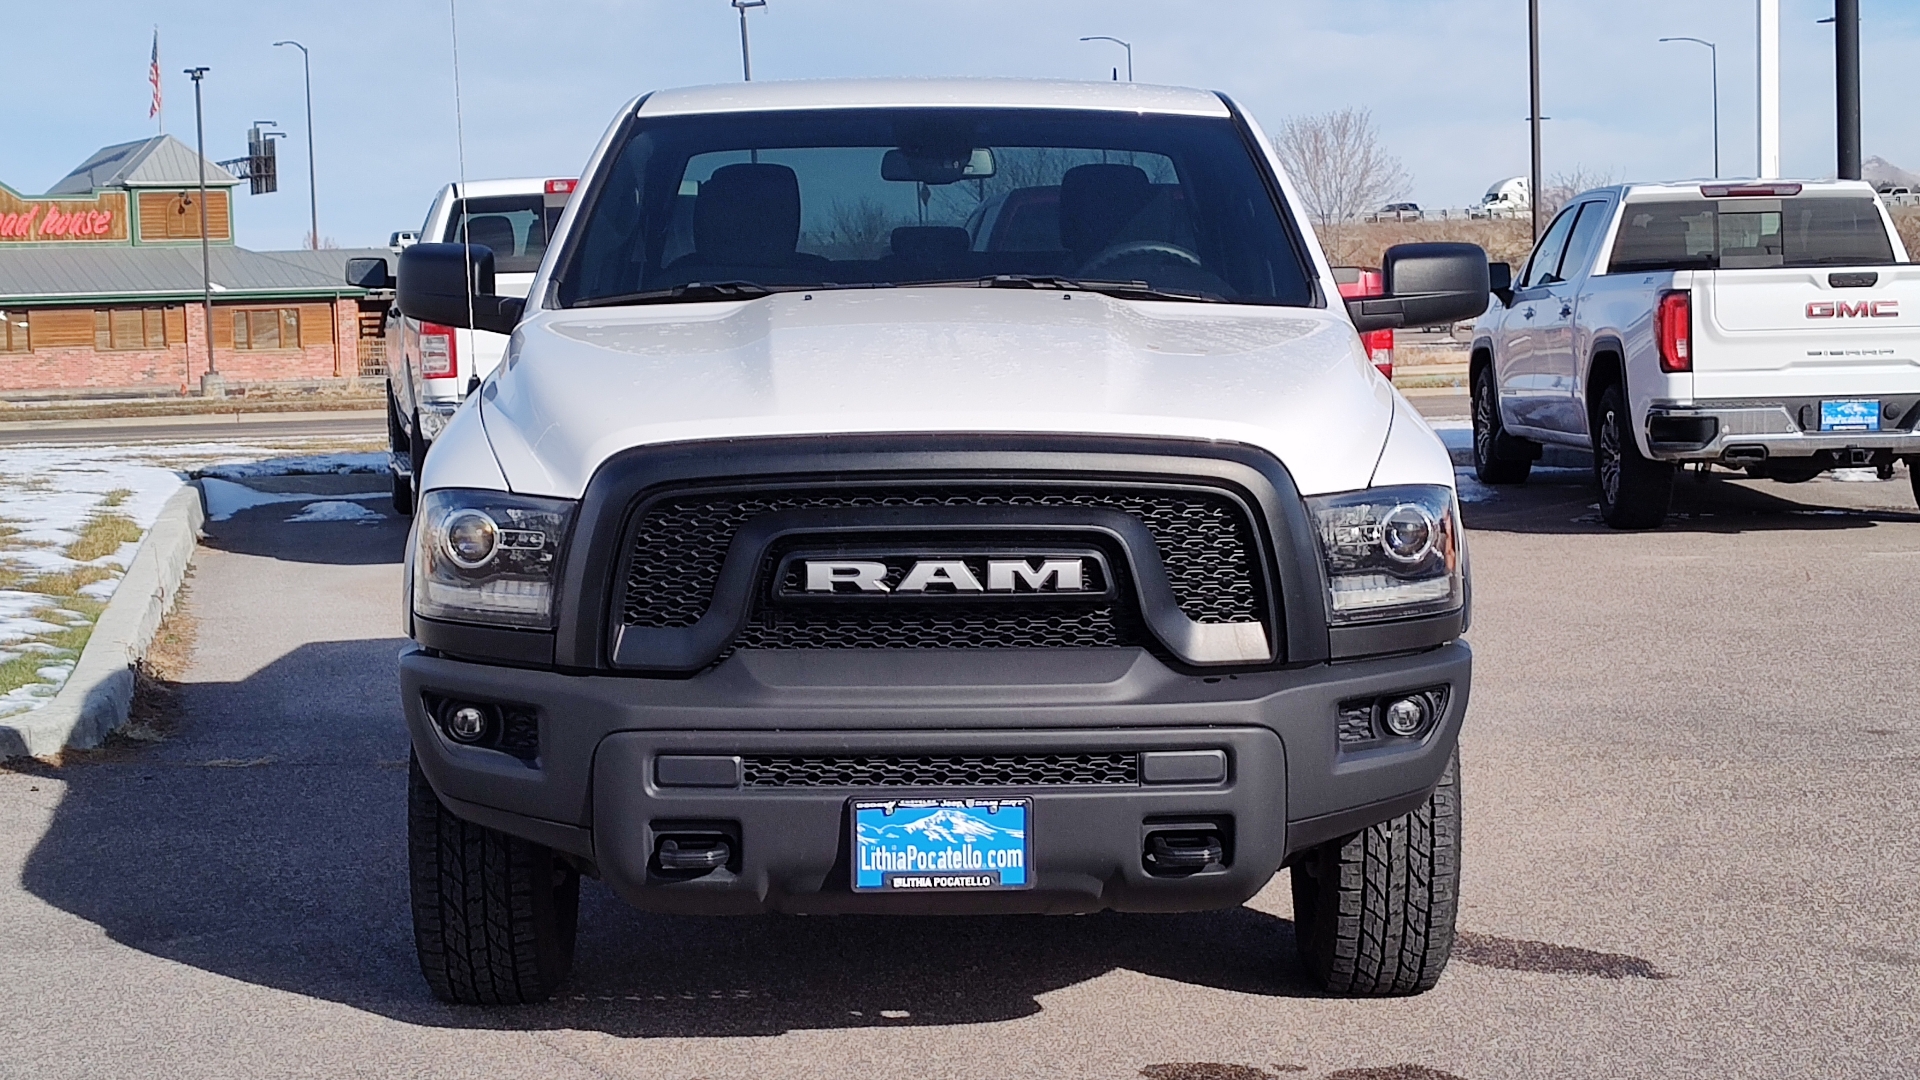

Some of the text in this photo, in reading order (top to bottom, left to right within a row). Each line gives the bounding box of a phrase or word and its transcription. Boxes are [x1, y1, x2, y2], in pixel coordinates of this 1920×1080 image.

[0, 204, 112, 237] ad house
[1805, 301, 1899, 319] GMC
[805, 560, 1083, 593] RAM
[861, 844, 1023, 871] LithiaPocatello.com
[933, 876, 991, 888] POCATELLO
